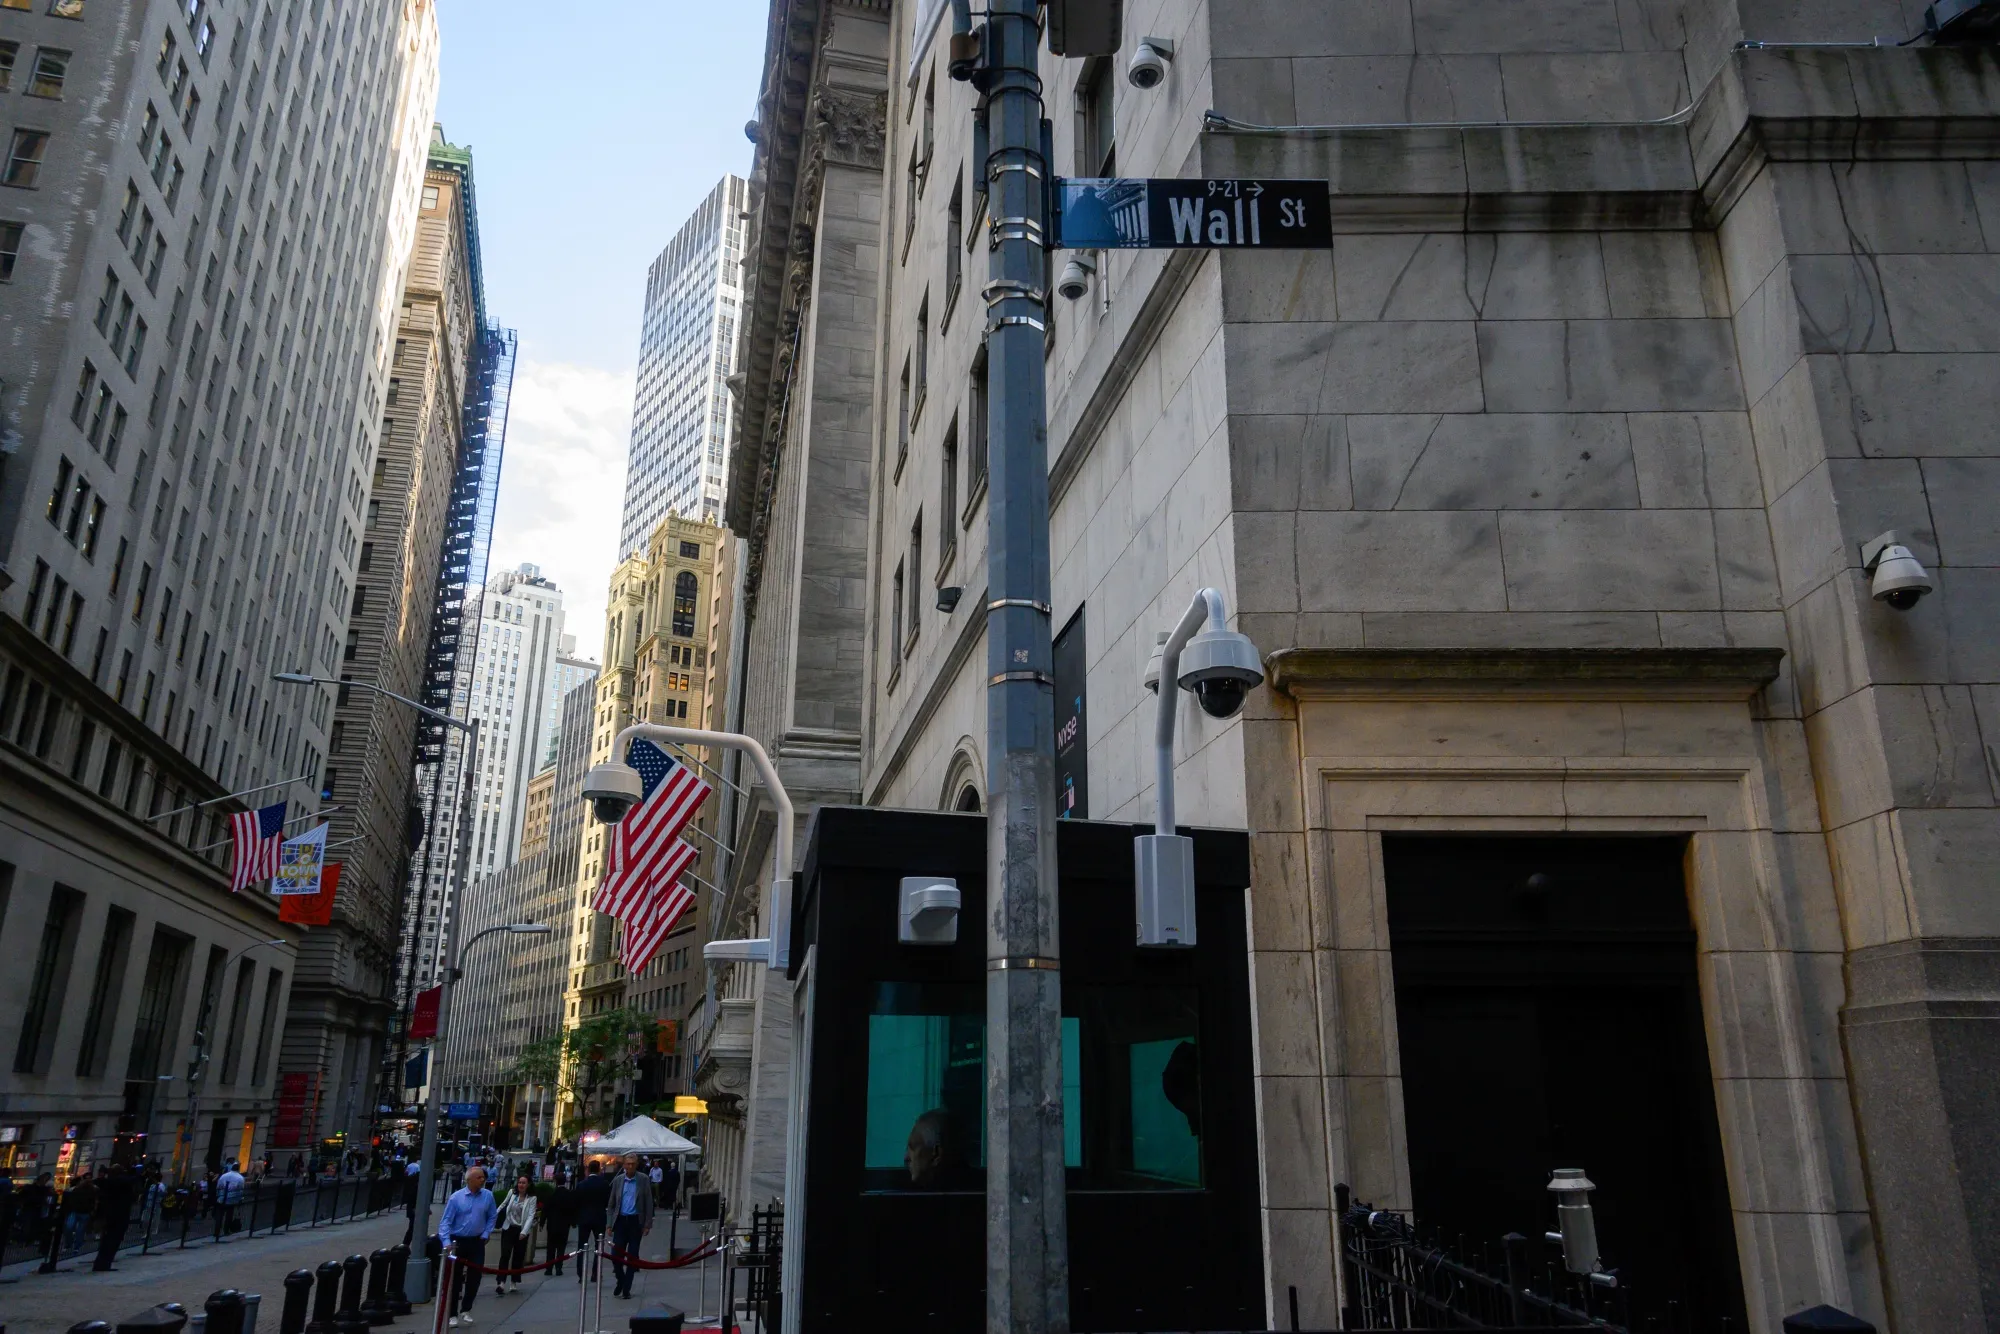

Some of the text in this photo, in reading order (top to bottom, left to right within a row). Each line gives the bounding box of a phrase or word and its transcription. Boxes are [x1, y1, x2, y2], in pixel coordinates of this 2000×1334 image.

[1207, 181, 1239, 197] 9-21
[1169, 197, 1307, 245] Wall St
[15, 1160, 36, 1168] GIFTS
